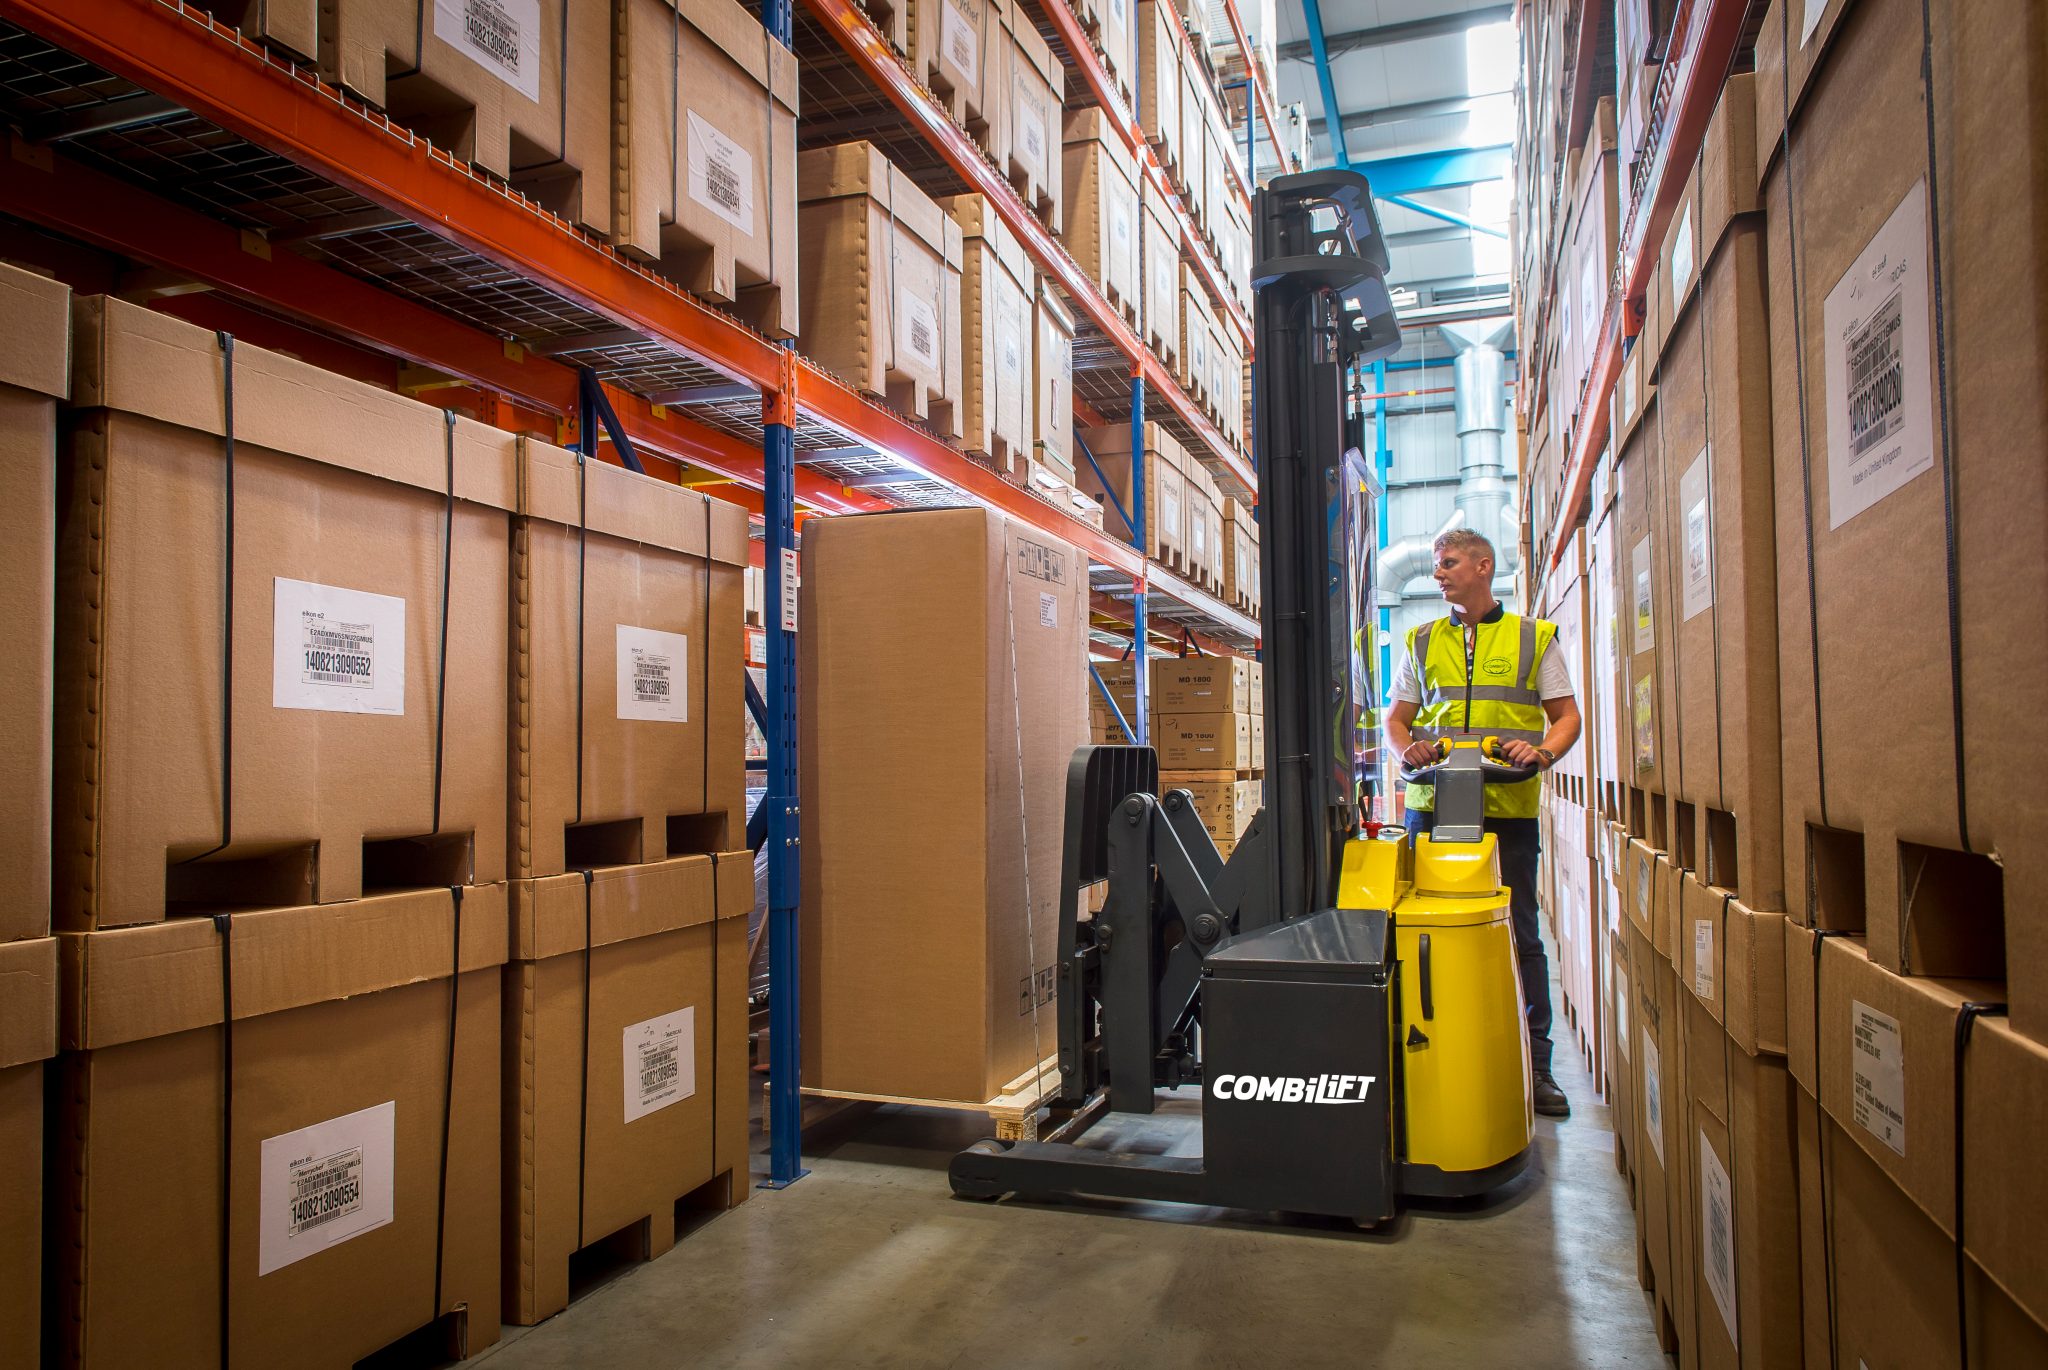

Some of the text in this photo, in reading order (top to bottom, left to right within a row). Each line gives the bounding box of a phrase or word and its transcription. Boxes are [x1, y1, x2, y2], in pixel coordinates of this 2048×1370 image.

[465, 15, 518, 66] 1408213090342
[1850, 362, 1902, 440] 1408213090280
[1869, 461, 1881, 476] United
[1882, 446, 1902, 464] Kingdom
[302, 610, 317, 618] eikon
[305, 650, 371, 676] 1408213090552
[1865, 1090, 1874, 1106] United
[1875, 1097, 1885, 1112] States
[1889, 1107, 1902, 1126] America
[298, 1164, 325, 1178] Merrychef
[292, 1180, 360, 1224] 1408213090554
